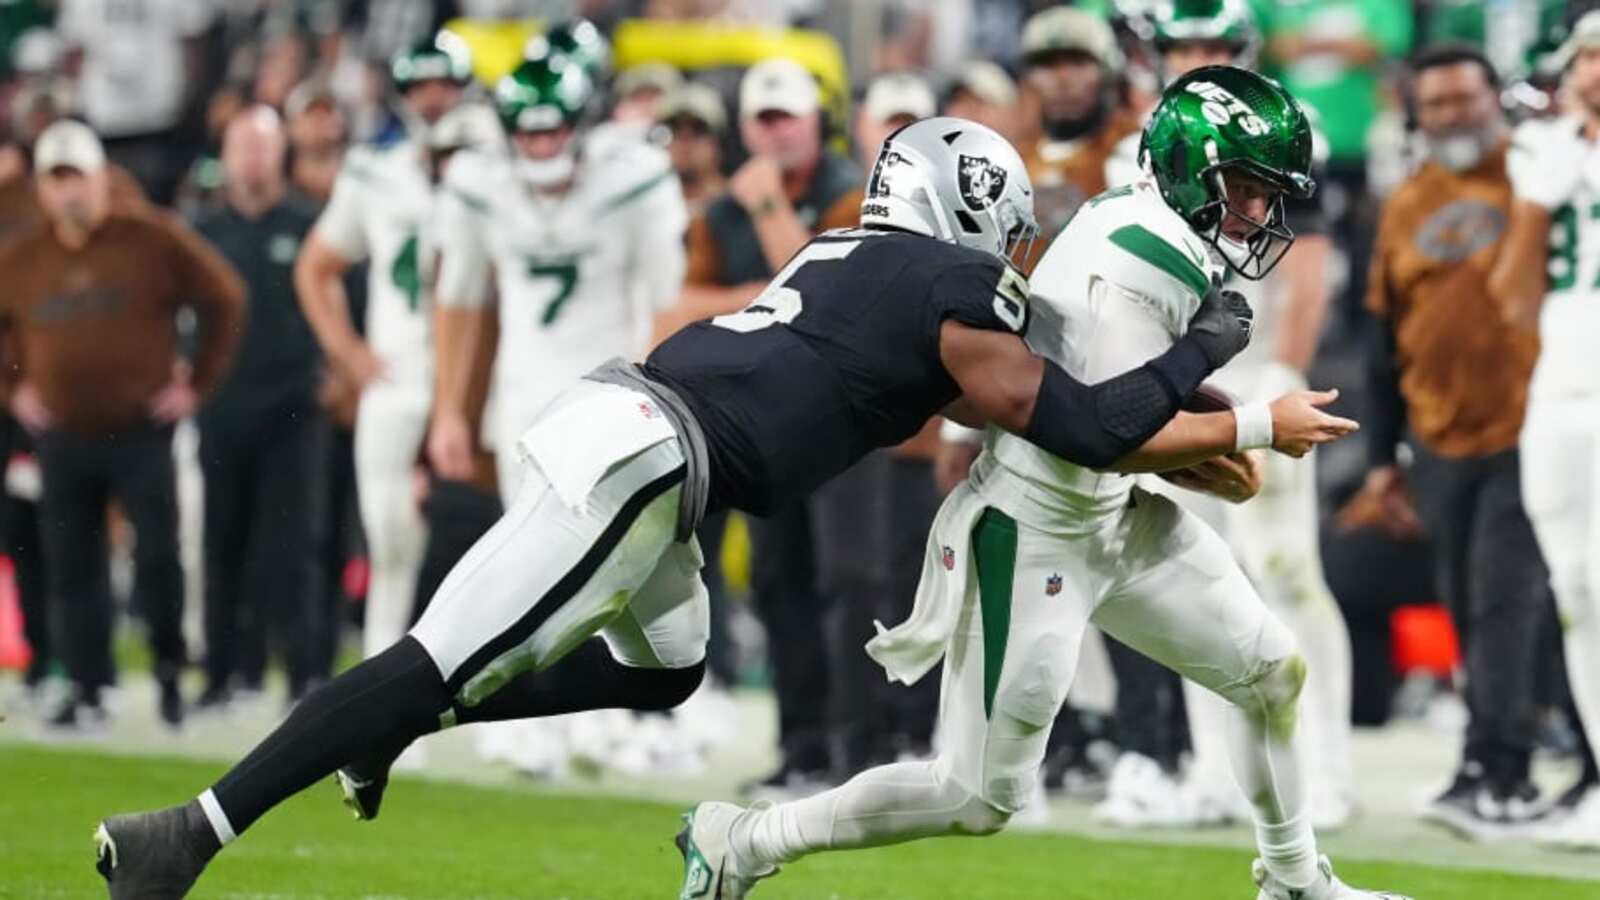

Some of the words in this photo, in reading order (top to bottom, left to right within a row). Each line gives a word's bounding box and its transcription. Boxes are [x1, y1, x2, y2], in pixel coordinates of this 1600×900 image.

[1185, 81, 1271, 136] JETS
[528, 262, 579, 326] 7
[711, 240, 863, 333] 5
[992, 265, 1030, 331] 5
